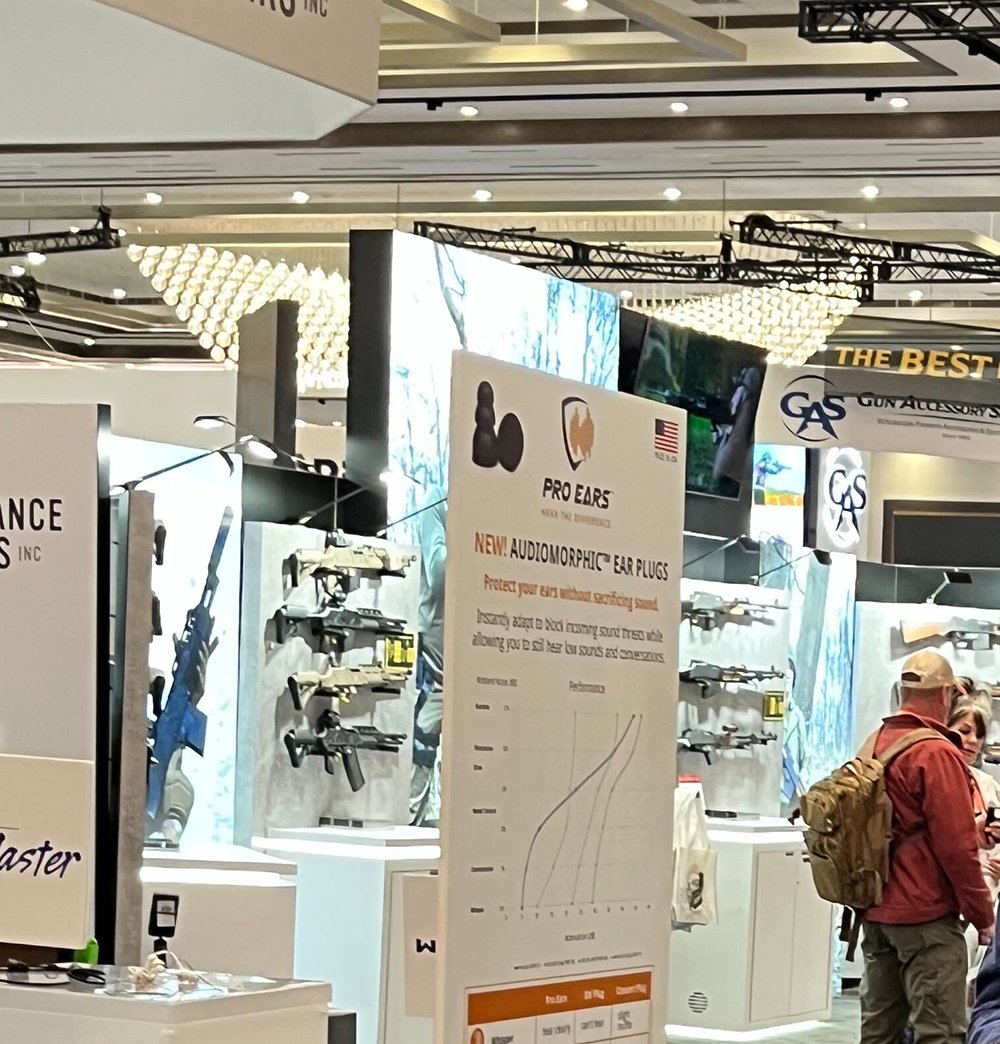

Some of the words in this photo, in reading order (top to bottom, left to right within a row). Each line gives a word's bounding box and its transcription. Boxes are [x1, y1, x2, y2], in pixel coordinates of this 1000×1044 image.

[835, 346, 891, 369] THE
[899, 347, 994, 379] BEST
[542, 477, 571, 502] PRO
[574, 483, 612, 509] EARS
[18, 545, 42, 561] INC
[475, 532, 507, 557] NEW!
[613, 555, 633, 577] EAR
[636, 558, 669, 581] PLUGS
